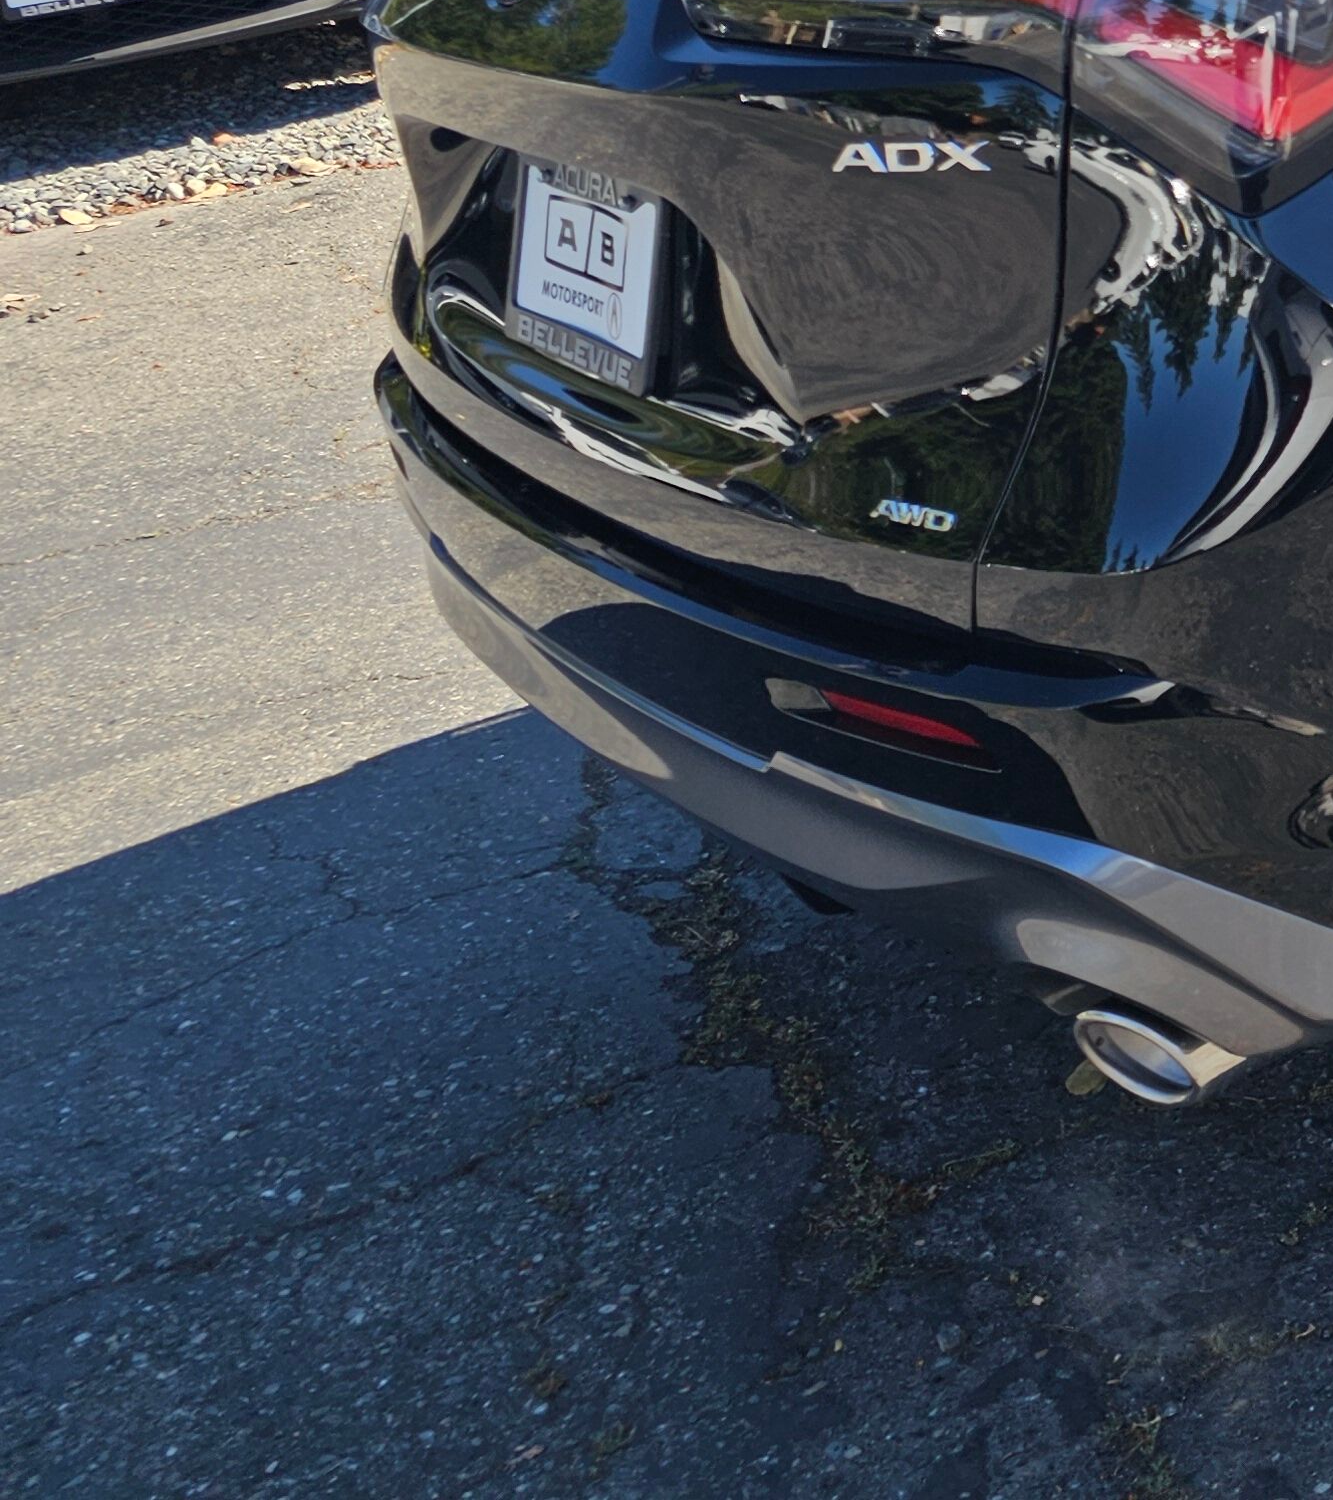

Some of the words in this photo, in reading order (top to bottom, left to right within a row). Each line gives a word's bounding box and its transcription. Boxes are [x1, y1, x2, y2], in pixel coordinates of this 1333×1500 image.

[832, 140, 991, 173] ADX
[551, 163, 619, 207] ACURA
[541, 280, 605, 318] MOTORSPORT
[516, 313, 632, 389] BELLEVUE
[869, 500, 956, 532] AWD
